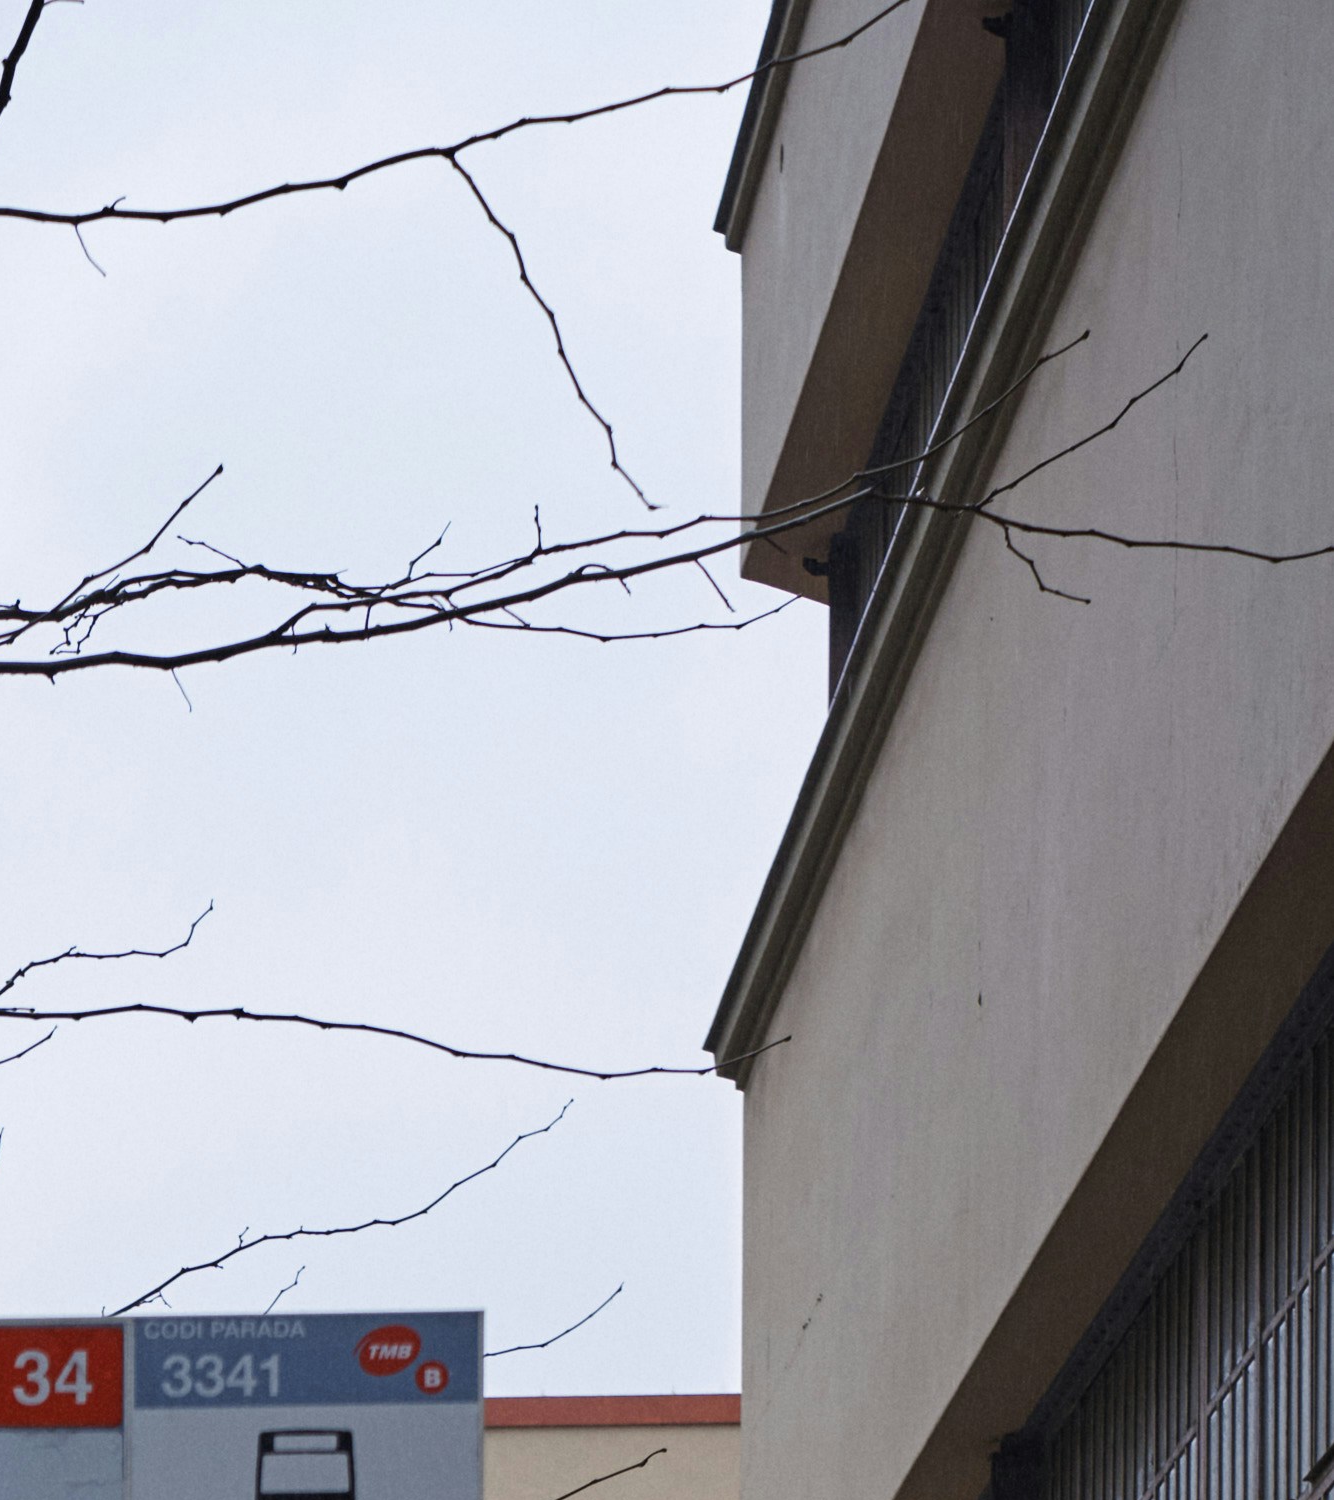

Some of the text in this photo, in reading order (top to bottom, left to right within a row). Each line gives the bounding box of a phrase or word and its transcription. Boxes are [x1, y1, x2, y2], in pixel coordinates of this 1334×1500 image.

[143, 1320, 308, 1340] CODI PARADA
[367, 1342, 414, 1362] TMB
[12, 1348, 93, 1406] 34
[161, 1353, 282, 1399] 3341
[423, 1368, 442, 1388] B
